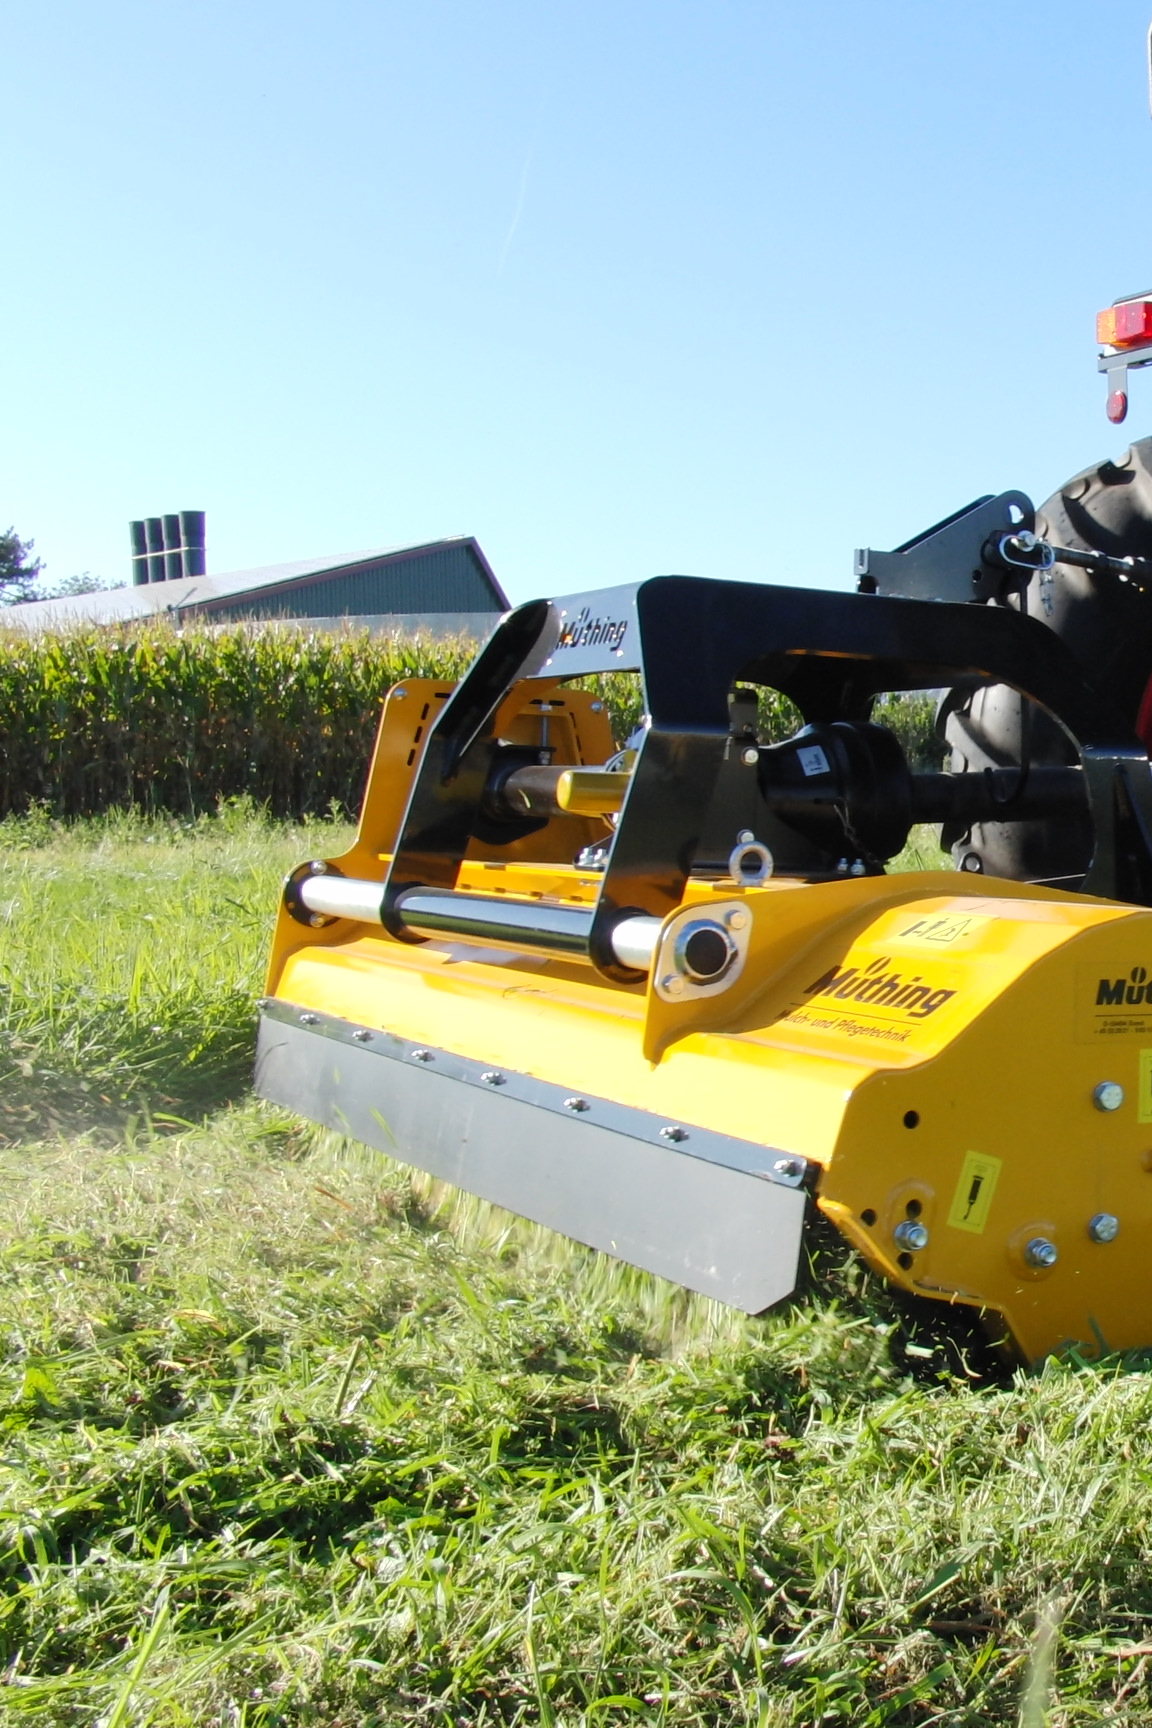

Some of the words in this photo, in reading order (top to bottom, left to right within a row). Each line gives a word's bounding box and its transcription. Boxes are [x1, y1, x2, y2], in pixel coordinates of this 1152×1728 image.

[555, 607, 628, 652] Müthing
[803, 956, 958, 1018] Müthing
[774, 1009, 809, 1023] Mulch-
[811, 1016, 834, 1028] und
[837, 1018, 912, 1042] Pflegetechnik
